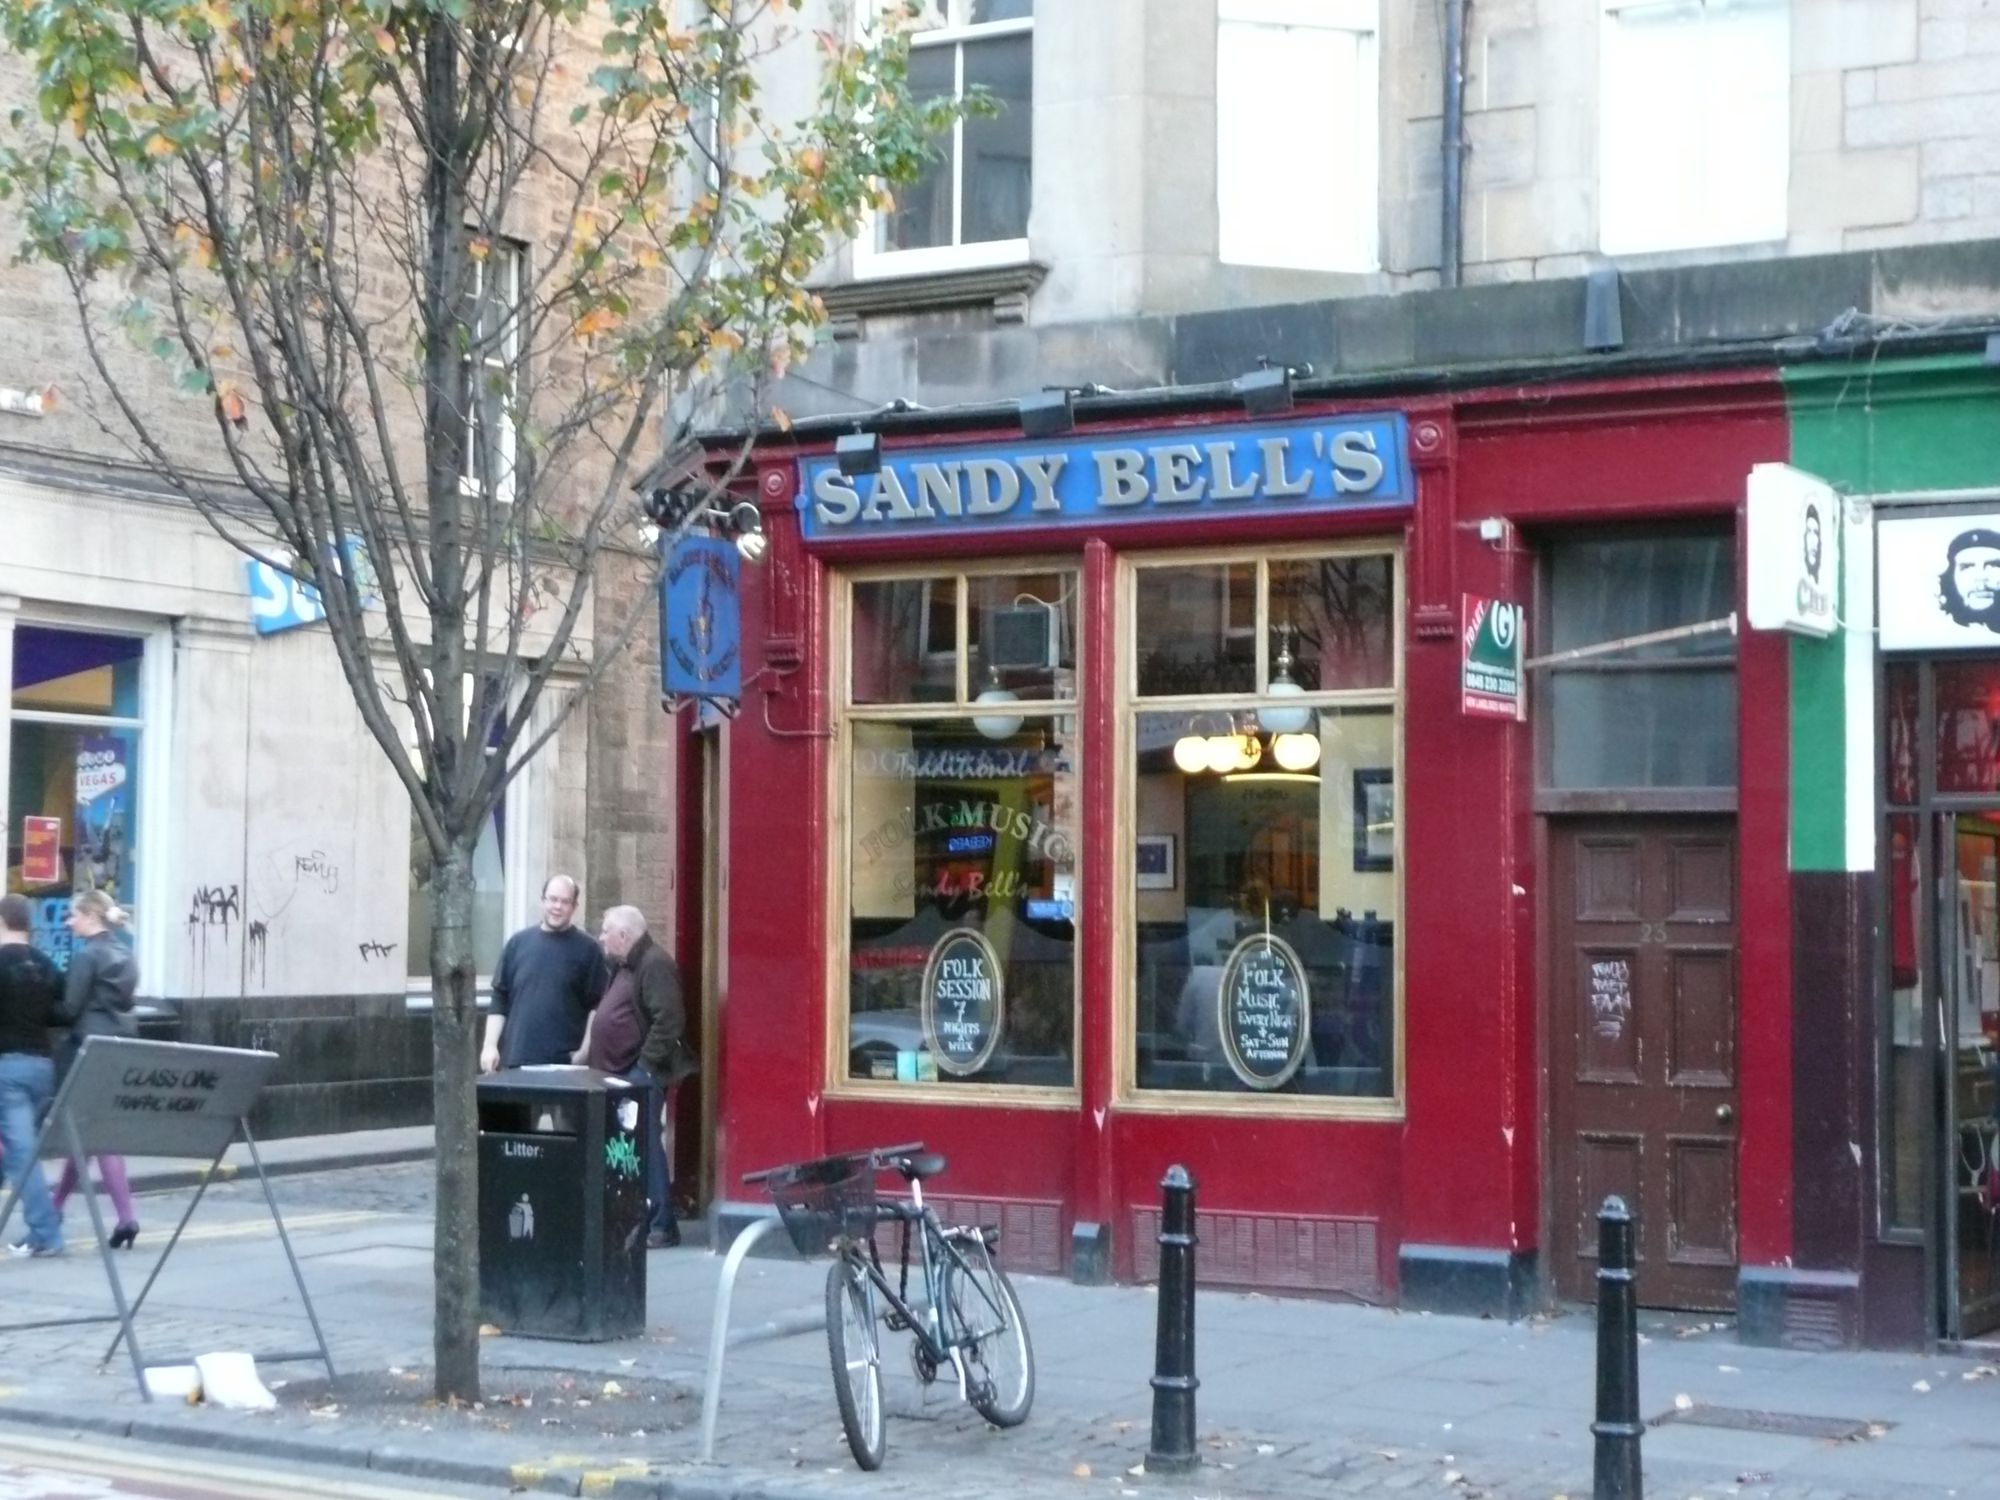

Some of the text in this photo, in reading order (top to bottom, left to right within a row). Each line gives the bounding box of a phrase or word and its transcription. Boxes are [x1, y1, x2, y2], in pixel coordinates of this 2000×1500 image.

[814, 430, 1385, 525] SANDY BELL'S
[79, 772, 117, 787] VEGAS
[859, 800, 1068, 864] FOLK MUSIC
[943, 958, 984, 978] FOLK
[1242, 962, 1286, 988] FOLK
[937, 978, 992, 1001] SESSION
[953, 1000, 966, 1023] 7
[943, 1022, 980, 1035] NIGHTS
[122, 1067, 179, 1088] CLASS
[504, 1141, 540, 1158] Litter
